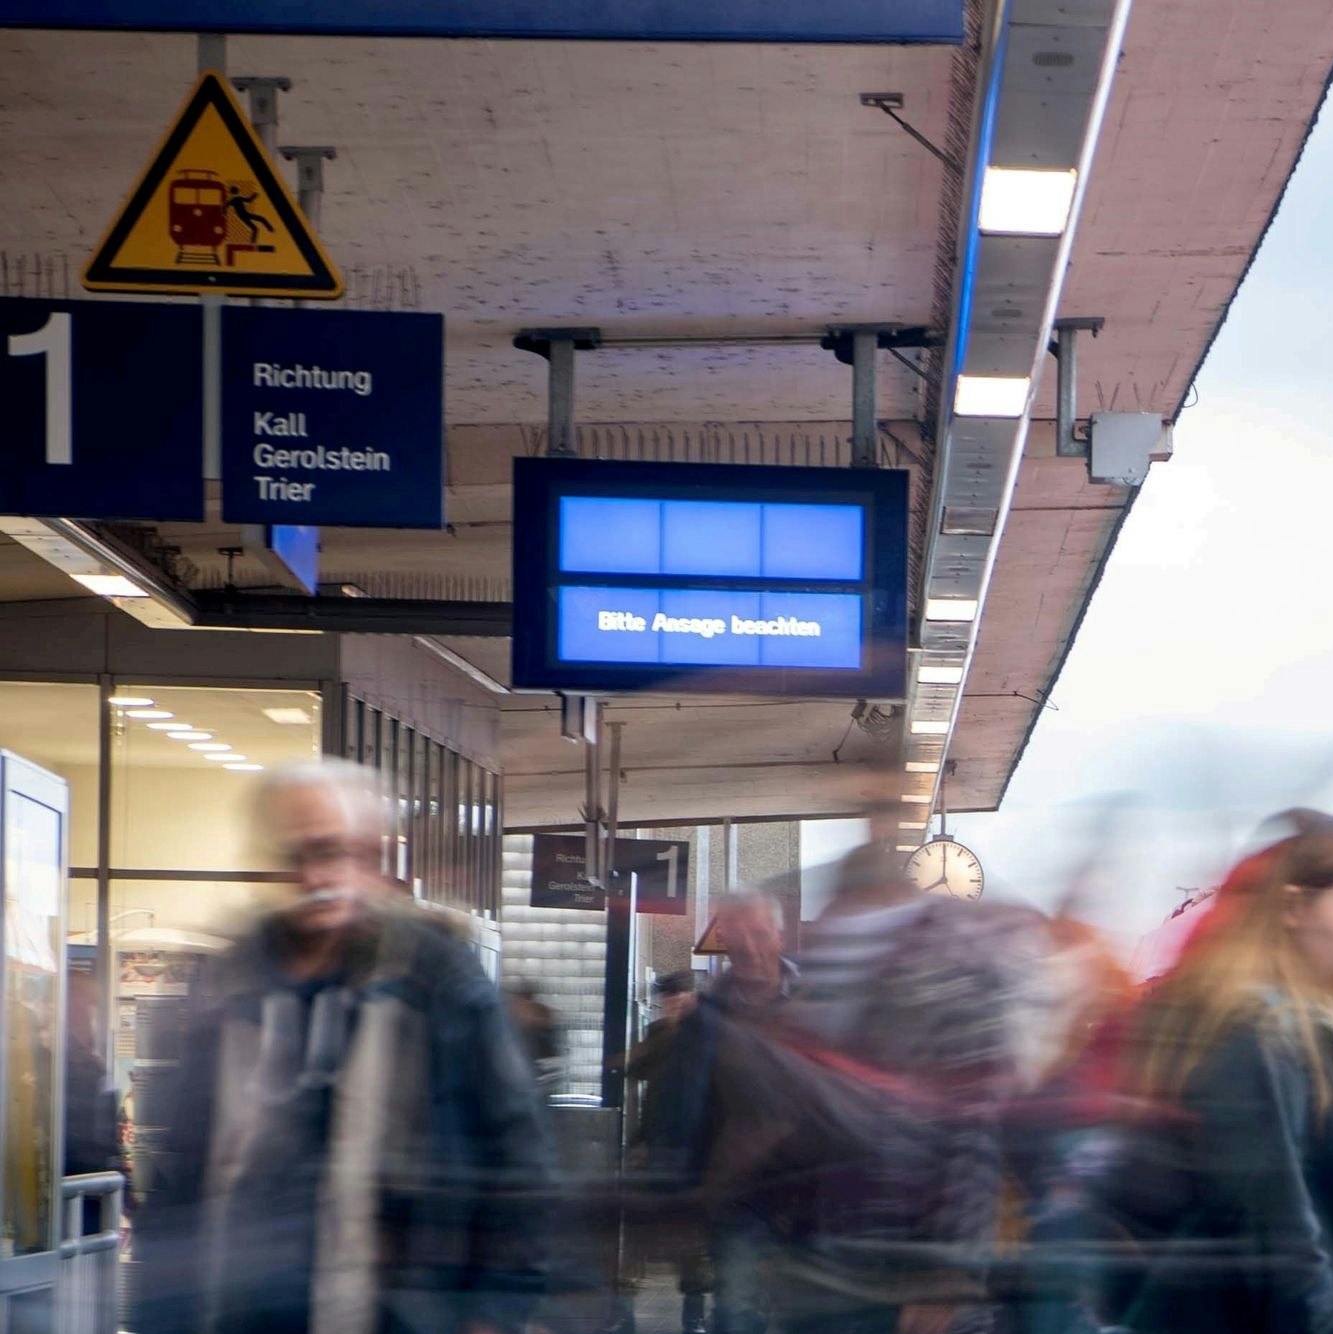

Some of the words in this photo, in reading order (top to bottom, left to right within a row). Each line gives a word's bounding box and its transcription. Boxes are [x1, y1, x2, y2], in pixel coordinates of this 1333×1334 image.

[7, 312, 72, 465] 1
[253, 362, 372, 396] Richtung
[253, 412, 308, 438] Kall
[253, 443, 391, 472] Gerolstein
[253, 476, 315, 502] Trier
[598, 611, 647, 632] Bitte
[652, 612, 726, 638] Ansage
[731, 615, 821, 637] beachten
[656, 846, 678, 898] 1
